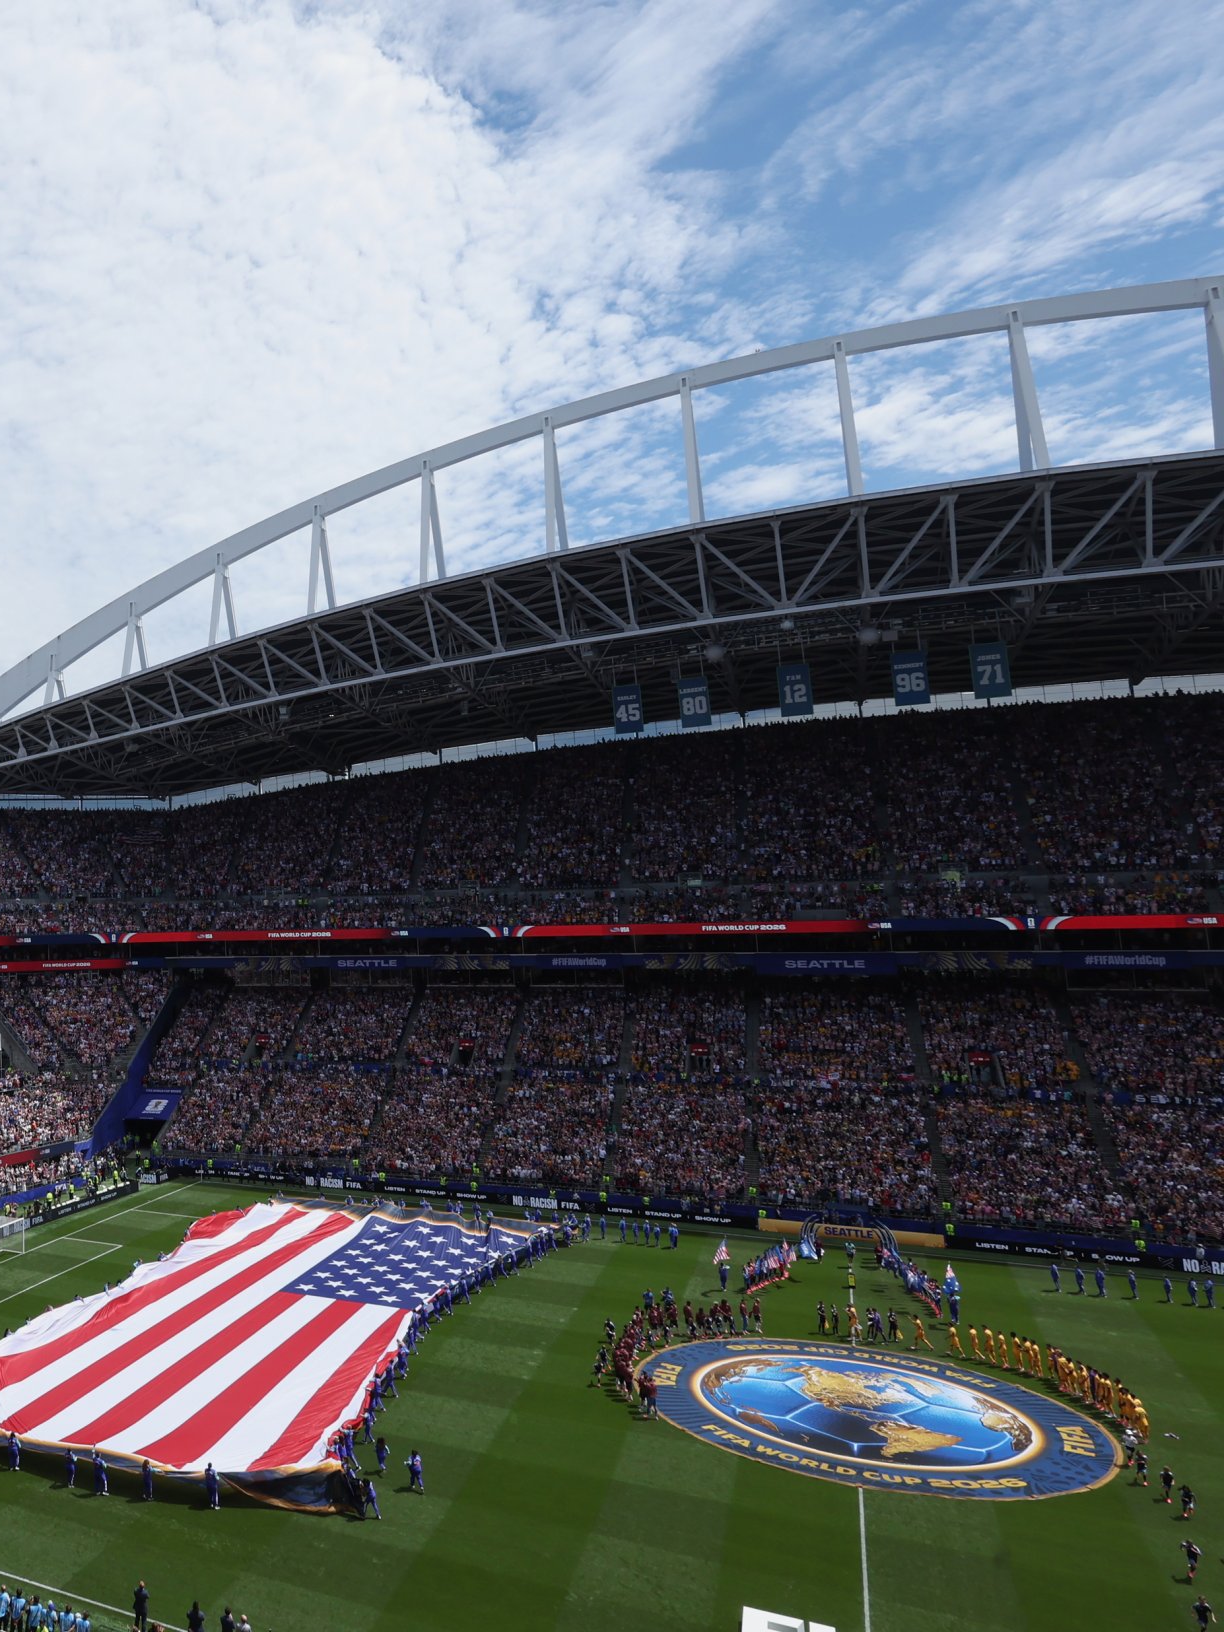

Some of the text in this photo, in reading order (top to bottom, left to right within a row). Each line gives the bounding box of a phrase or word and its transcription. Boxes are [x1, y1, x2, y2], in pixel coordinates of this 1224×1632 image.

[977, 663, 1005, 685] 71
[895, 672, 926, 693] 96
[783, 683, 807, 704] 12
[616, 703, 640, 722] 45
[681, 696, 707, 716] 80
[337, 959, 397, 967] SEATTLE
[552, 957, 607, 968] #FIFAWorldCup
[784, 960, 865, 969] SEATTLE
[1085, 955, 1166, 967] #FIFAWorldCup
[306, 1176, 362, 1190] NO RACISM FIFA
[512, 1195, 580, 1211] NO RACISM FIFA
[645, 1210, 670, 1218] STAND
[824, 1226, 873, 1239] SEATTLE
[975, 1242, 1009, 1250] LISTEN
[1182, 1258, 1200, 1273] NO
[804, 1346, 849, 1355] CUP
[853, 1352, 939, 1373] WORLD
[652, 1362, 683, 1386] FIFA
[1055, 1426, 1096, 1457] FIFA
[701, 1424, 1027, 1489] FIFA WORLD CUP 2026
